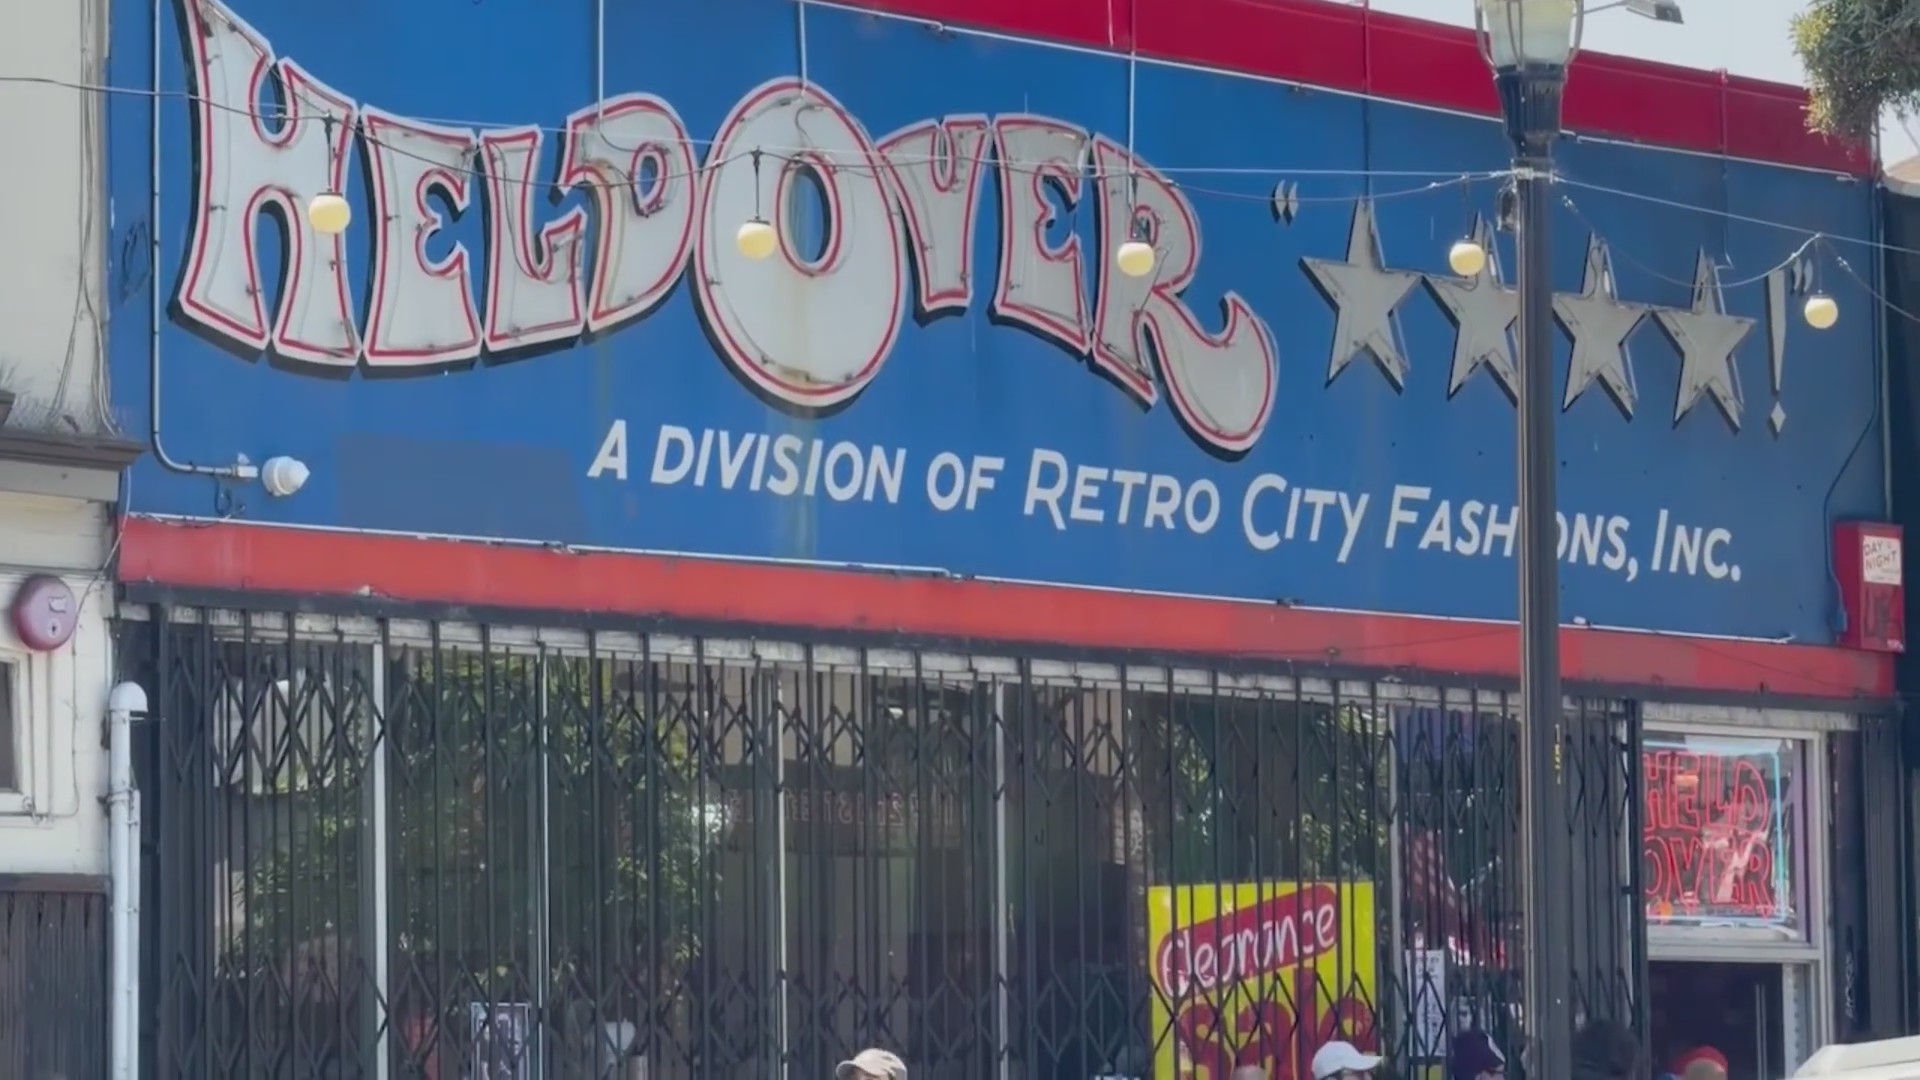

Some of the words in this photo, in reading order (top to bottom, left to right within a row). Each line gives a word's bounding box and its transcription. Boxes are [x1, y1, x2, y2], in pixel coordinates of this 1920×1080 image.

[587, 419, 628, 480] A
[650, 424, 907, 503] DIVISION
[926, 451, 1005, 511] OF
[1024, 448, 1220, 533] RETRO
[1242, 473, 1370, 563] CITY
[1384, 485, 1638, 582] FASHNS,
[1651, 508, 1741, 582] INC.
[1865, 550, 1897, 571] NIGHT
[1644, 749, 1769, 834] HELD
[1160, 903, 1336, 998] Clearance
